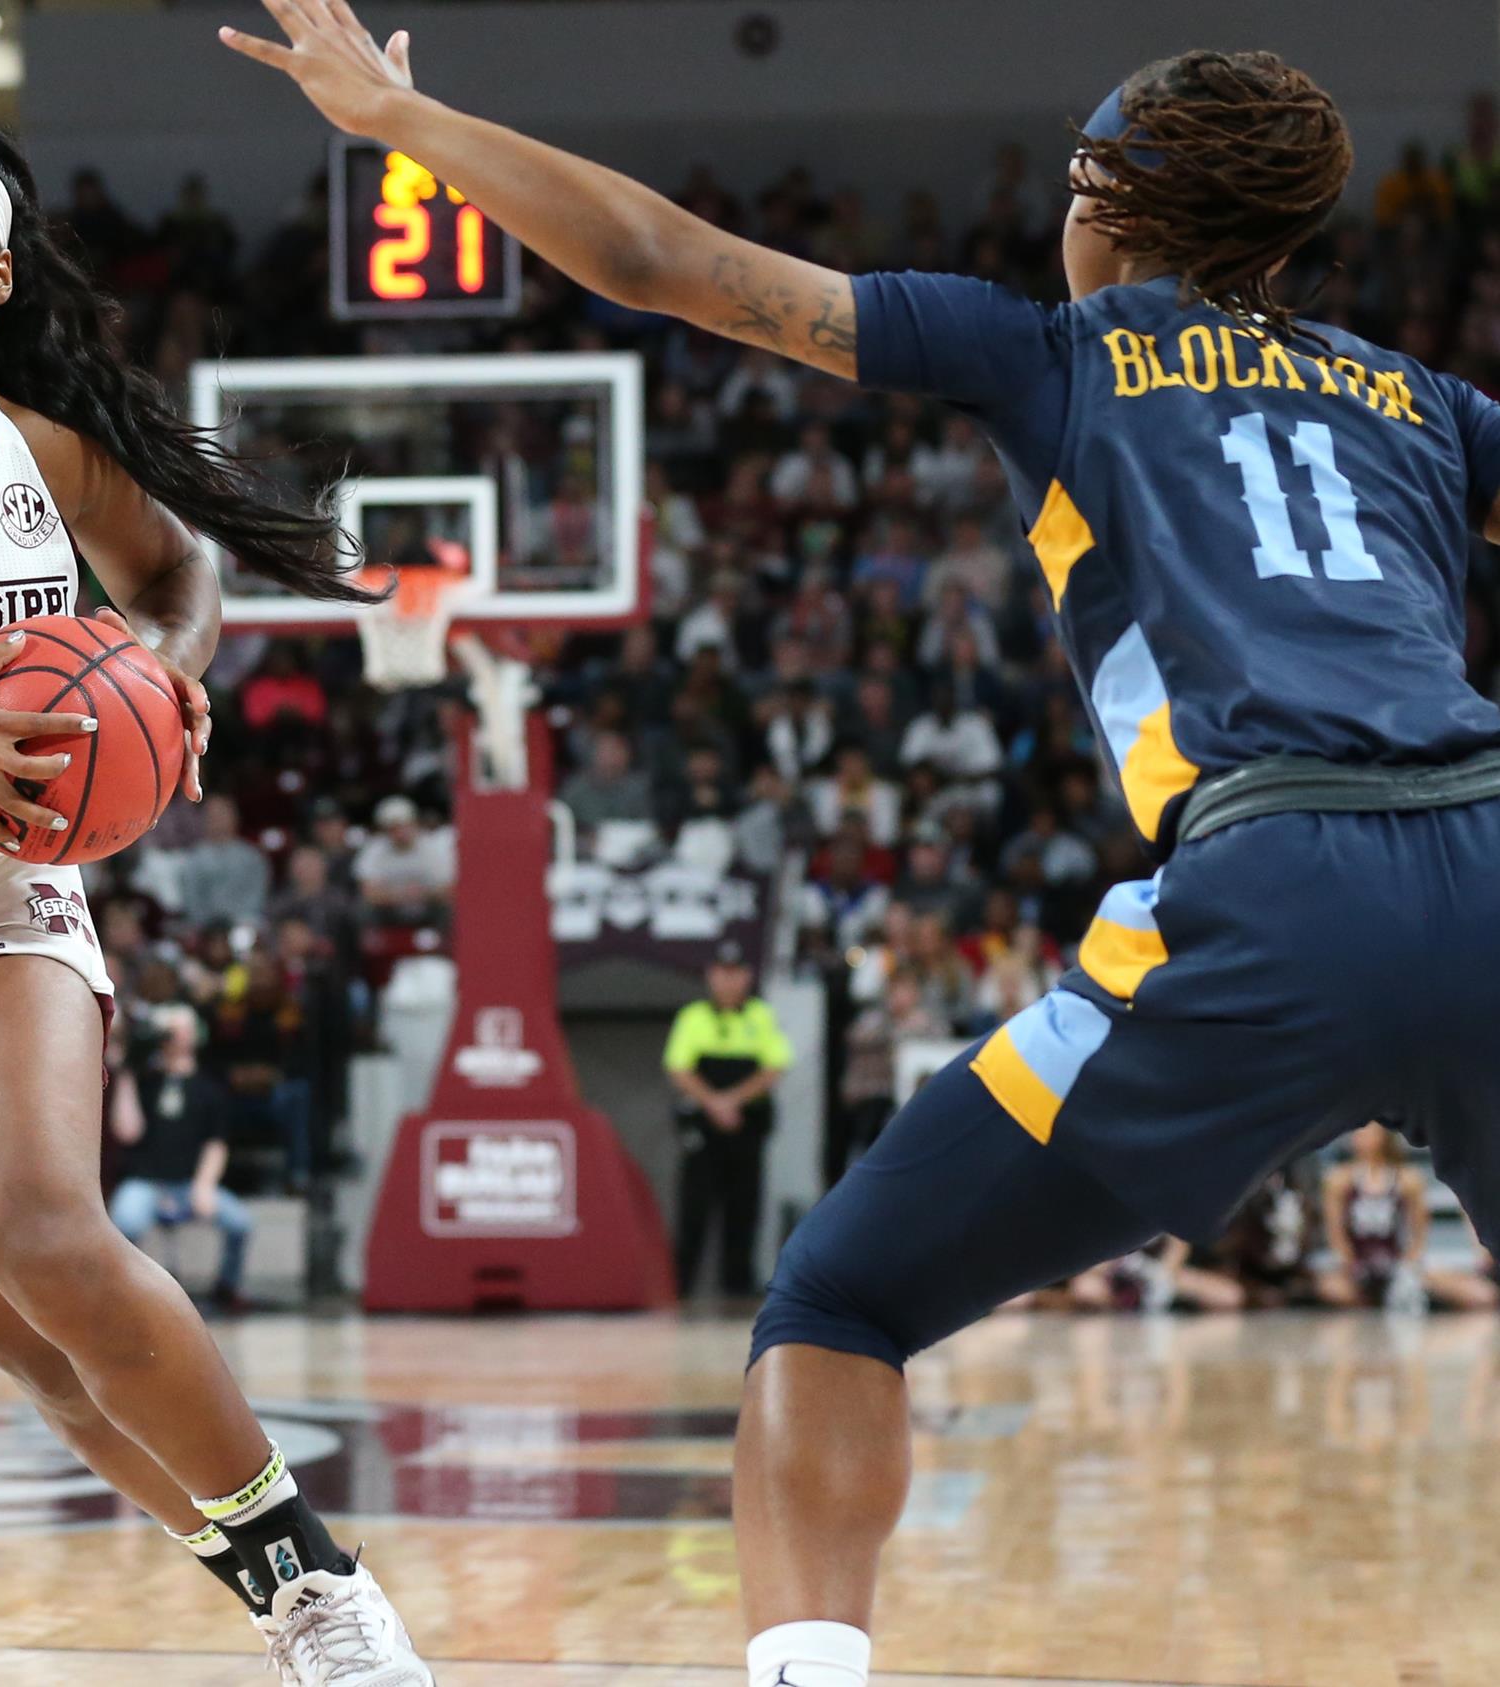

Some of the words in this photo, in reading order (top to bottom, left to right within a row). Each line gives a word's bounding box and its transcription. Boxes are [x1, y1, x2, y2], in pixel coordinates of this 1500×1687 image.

[370, 203, 484, 299] 21
[3, 484, 45, 533] SEC
[1220, 412, 1384, 581] 11
